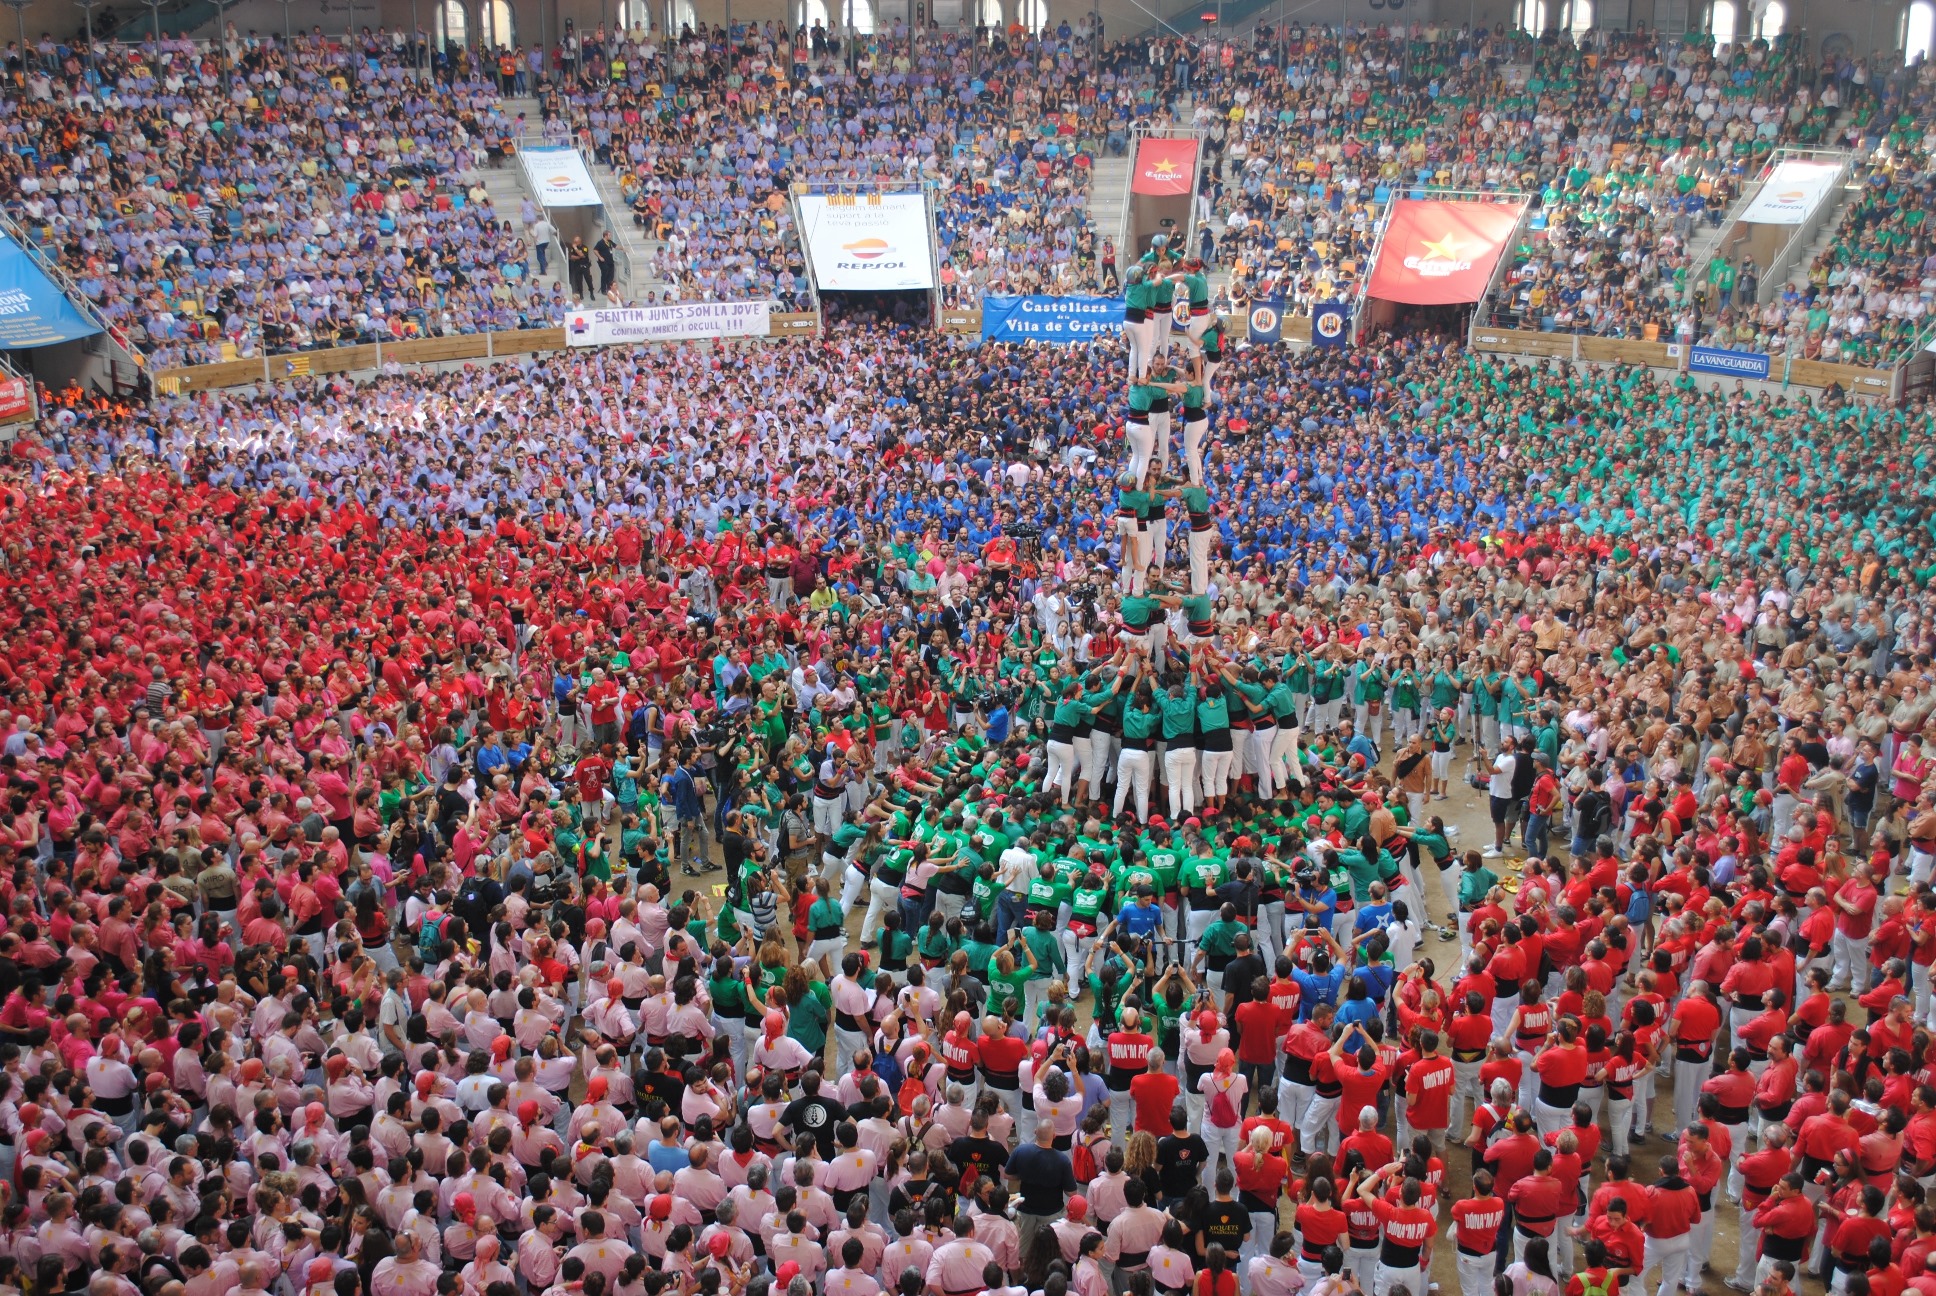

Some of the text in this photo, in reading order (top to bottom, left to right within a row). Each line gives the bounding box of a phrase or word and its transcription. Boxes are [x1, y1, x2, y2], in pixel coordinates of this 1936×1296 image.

[837, 261, 907, 269] REPSOL
[594, 303, 760, 323] SENTIM JUNTS SOM LA JOVE
[1021, 300, 1107, 313] Castellers
[688, 321, 721, 332] ORGULL
[1005, 319, 1124, 332] Vila de Gràcia
[1694, 354, 1763, 371] LA VANGUARDIA
[1464, 1211, 1494, 1230] DÓNA'M
[1415, 1221, 1429, 1240] PIT
